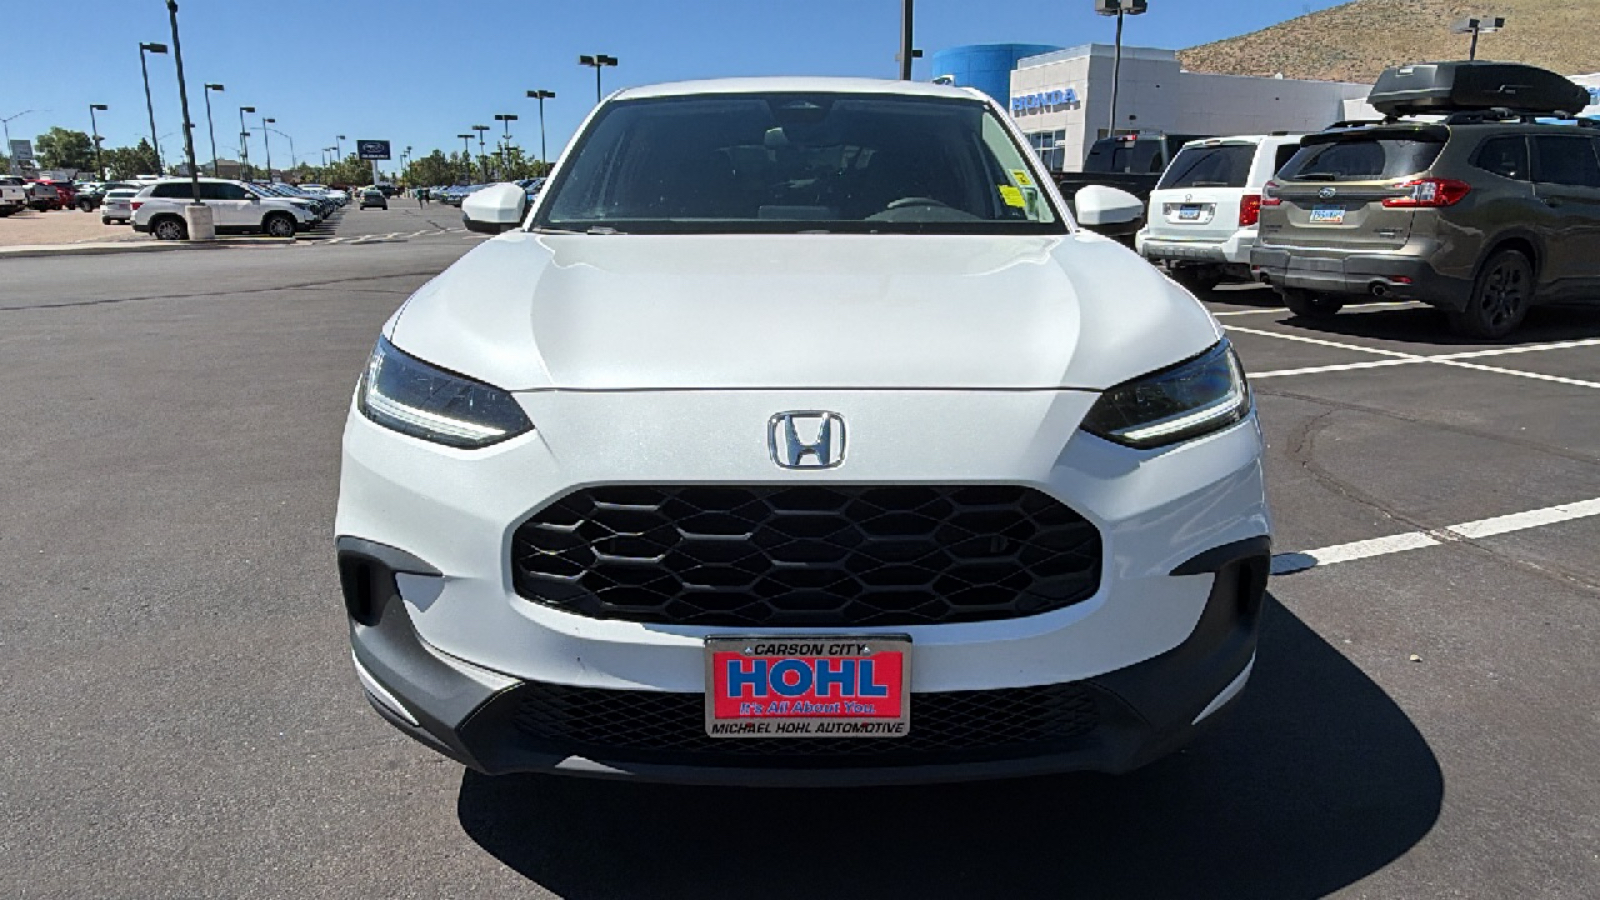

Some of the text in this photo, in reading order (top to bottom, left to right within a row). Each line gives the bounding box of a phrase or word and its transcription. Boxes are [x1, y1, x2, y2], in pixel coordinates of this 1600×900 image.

[1011, 89, 1076, 110] HONDA
[754, 644, 866, 656] CARSON CITY
[727, 659, 889, 698] HOHL
[739, 701, 763, 715] It's
[765, 701, 790, 715] All
[792, 701, 840, 715] About
[711, 722, 905, 735] MICHAEL HOHL AUTOMOTIVE
